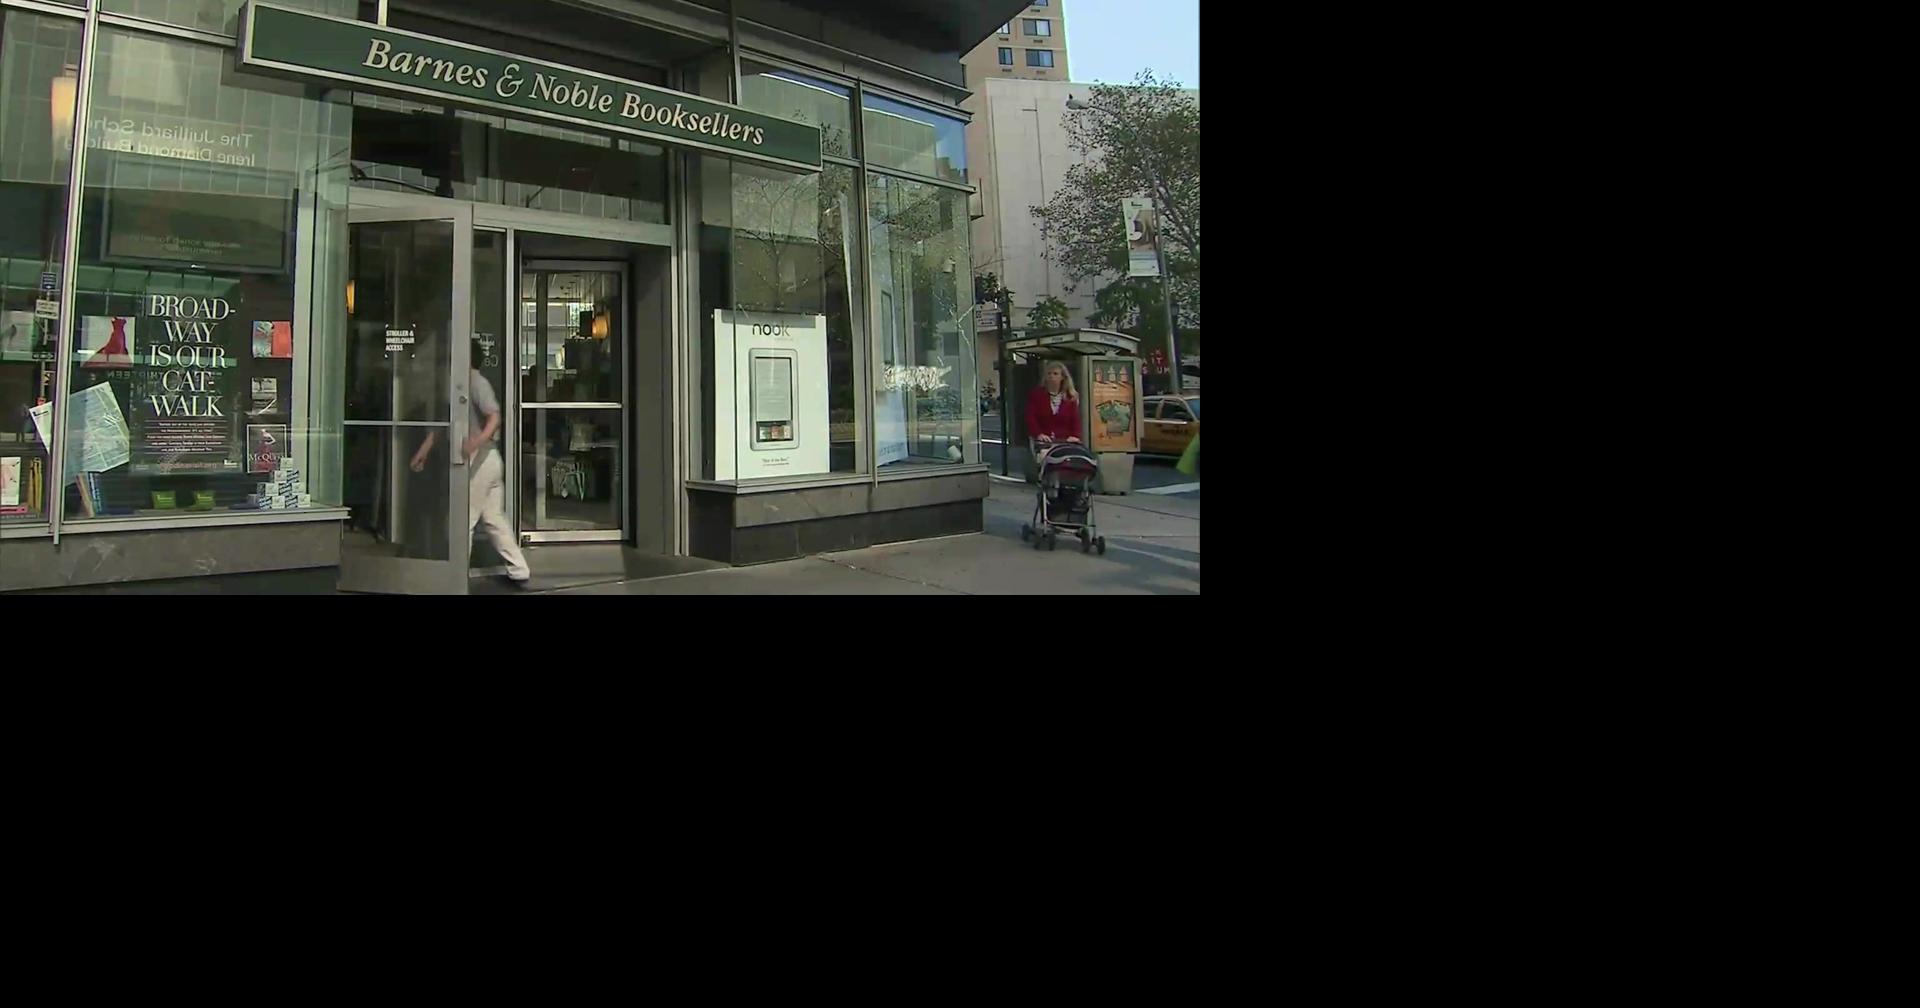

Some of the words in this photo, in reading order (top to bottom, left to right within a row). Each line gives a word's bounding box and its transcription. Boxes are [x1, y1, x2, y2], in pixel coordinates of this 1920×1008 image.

[362, 38, 489, 88] Barnes
[495, 63, 524, 98] &
[528, 72, 613, 113] Noble
[619, 92, 764, 145] Booksellers
[149, 294, 236, 320] BROAD-
[164, 320, 219, 343] WAY
[385, 329, 409, 337] STROLLER
[752, 319, 791, 336] nook
[149, 344, 172, 367] IS
[175, 344, 228, 368] OUR
[162, 369, 215, 392] CAT-
[149, 394, 225, 417] WALK
